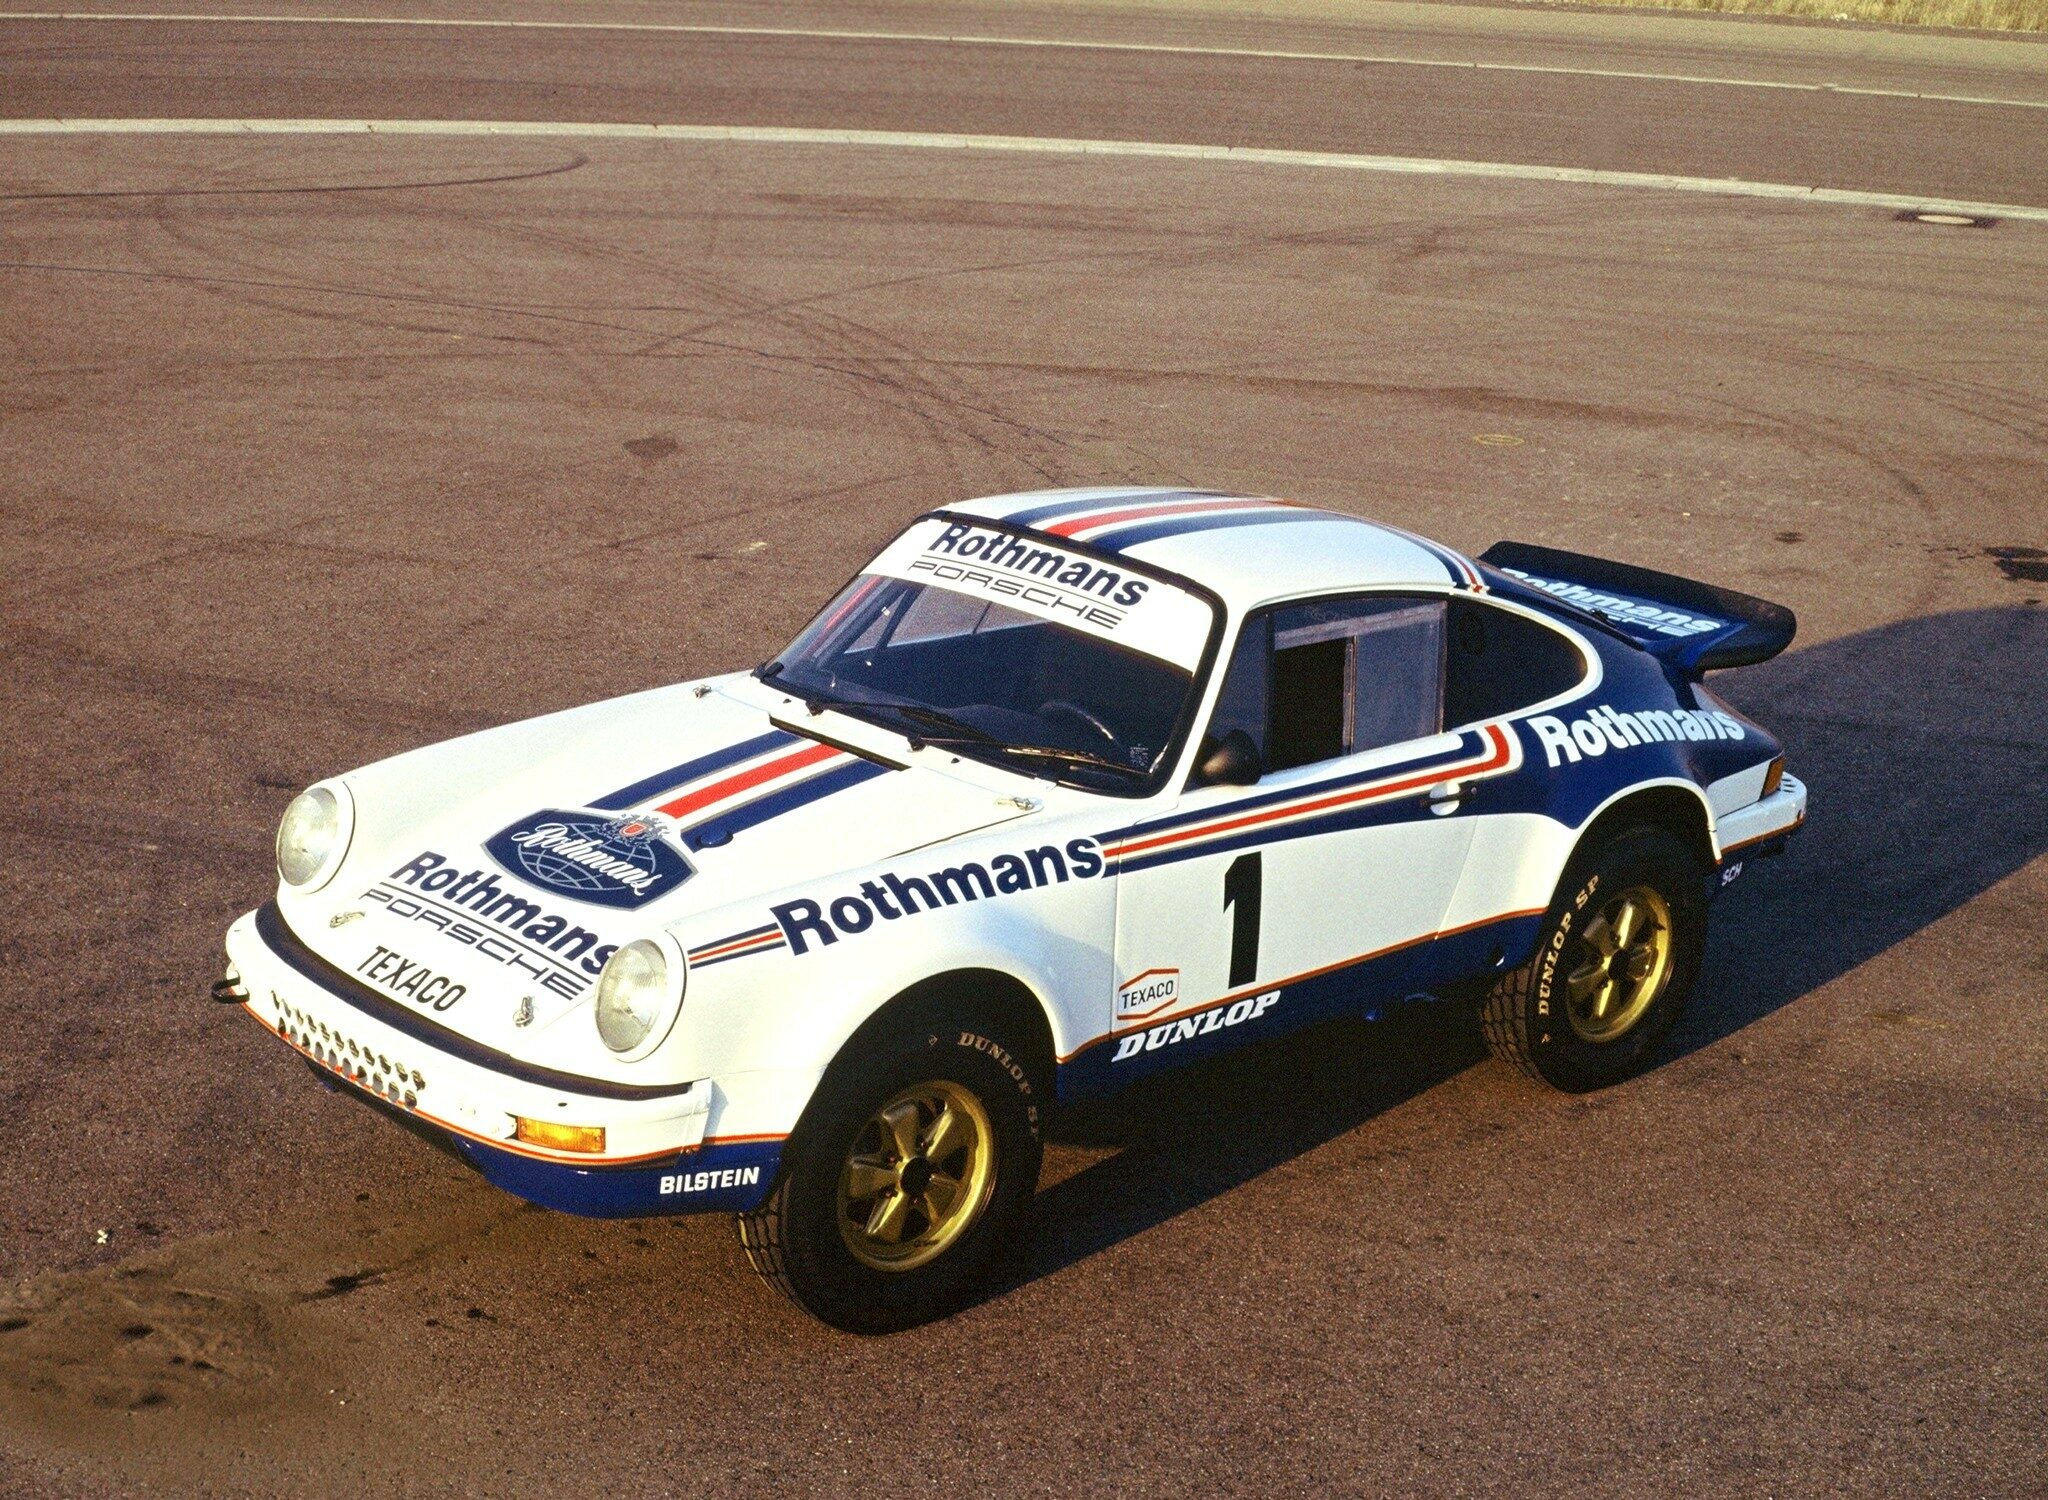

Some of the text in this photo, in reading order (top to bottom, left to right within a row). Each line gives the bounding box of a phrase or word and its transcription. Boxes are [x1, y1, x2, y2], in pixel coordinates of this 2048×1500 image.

[908, 560, 1124, 629] PORSCHE
[928, 522, 1150, 606] Rothmans
[1526, 704, 1746, 768] Rothmans
[511, 822, 662, 897] Rothmans
[388, 850, 620, 976] Rothmans
[768, 838, 1103, 957] Rothmans
[1222, 850, 1263, 990] 1
[356, 945, 468, 1012] TEXACO
[358, 888, 586, 1001] PORSCHE
[1537, 874, 1599, 1016] DUNLOP SP
[1110, 989, 1282, 1063] DUNLOP
[1121, 979, 1175, 1010] TEXACO
[957, 1031, 1033, 1095] DUNLOP
[659, 1166, 760, 1195] BILSTEIN
